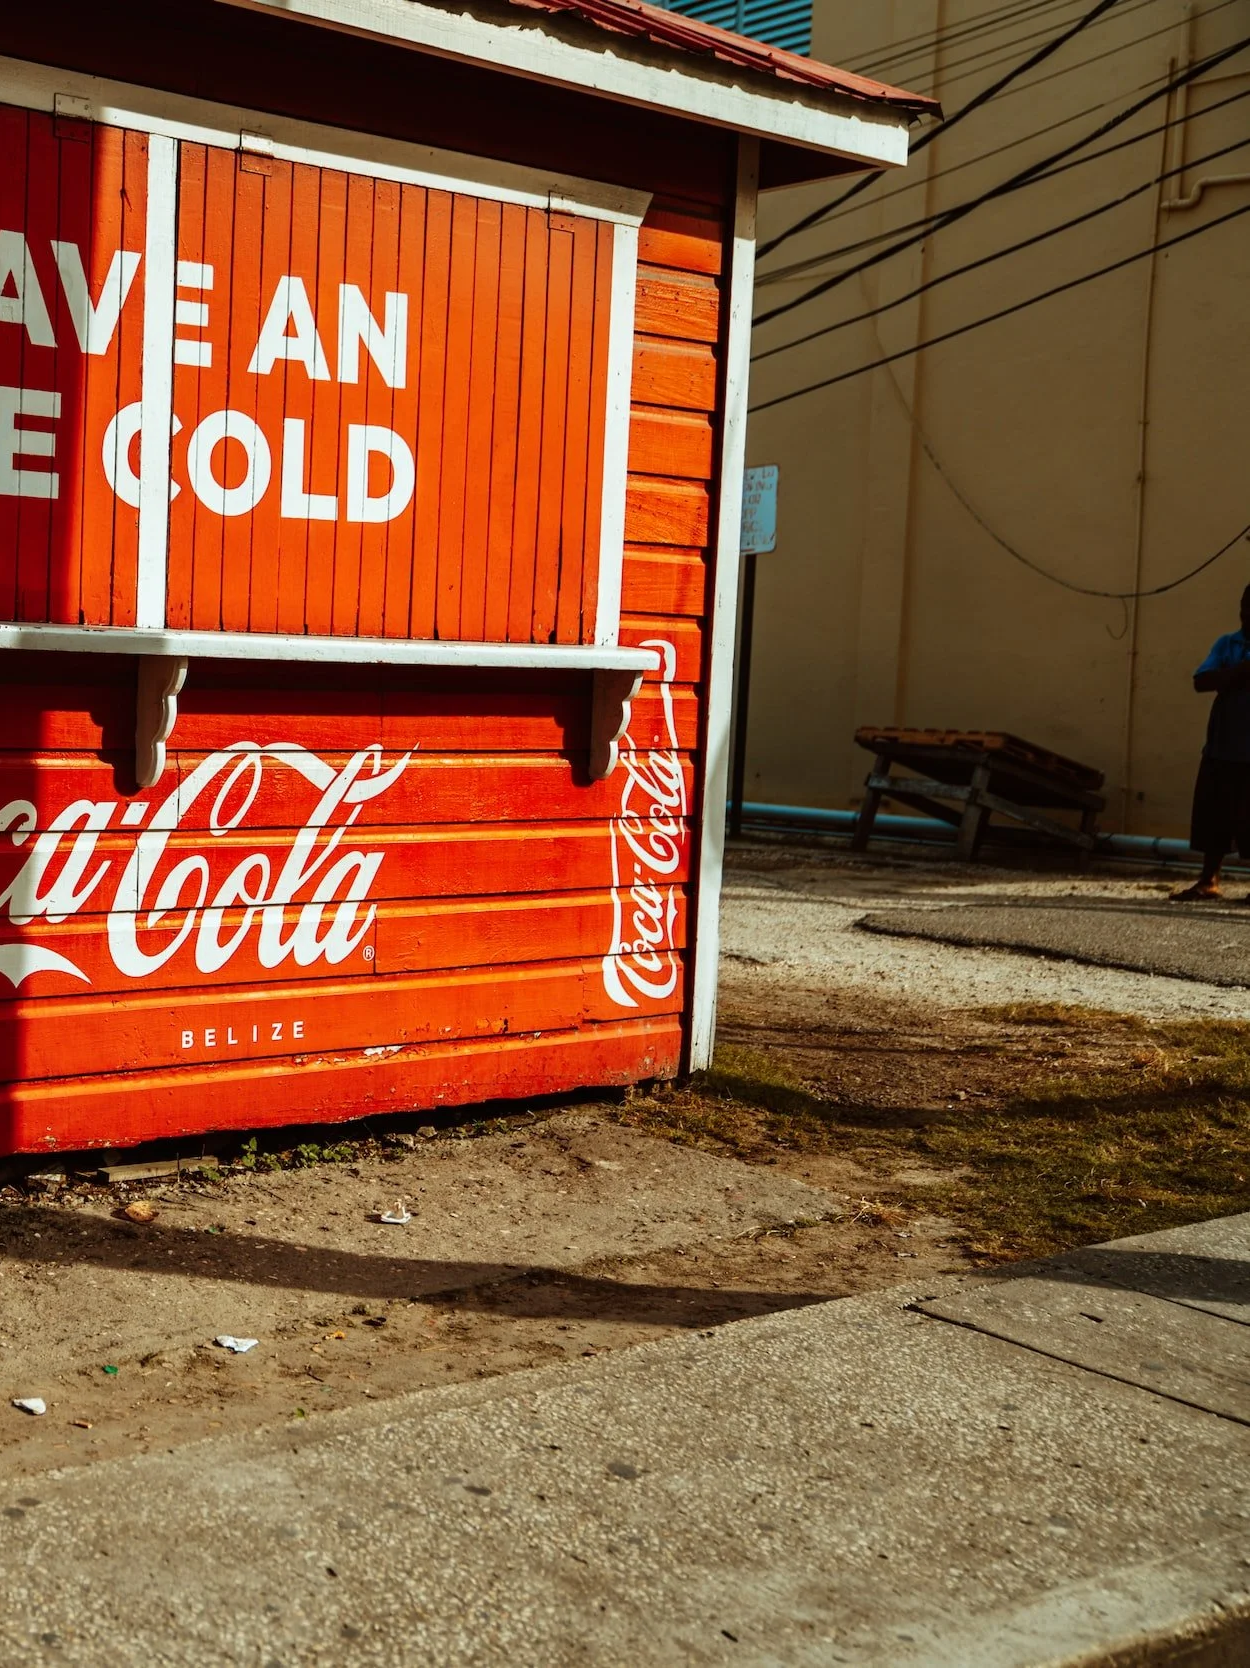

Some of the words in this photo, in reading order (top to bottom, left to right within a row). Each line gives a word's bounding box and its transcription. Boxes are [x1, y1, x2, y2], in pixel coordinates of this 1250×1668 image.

[247, 276, 408, 389] AN
[102, 401, 416, 524] COLD
[181, 1021, 304, 1048] BELIZE
